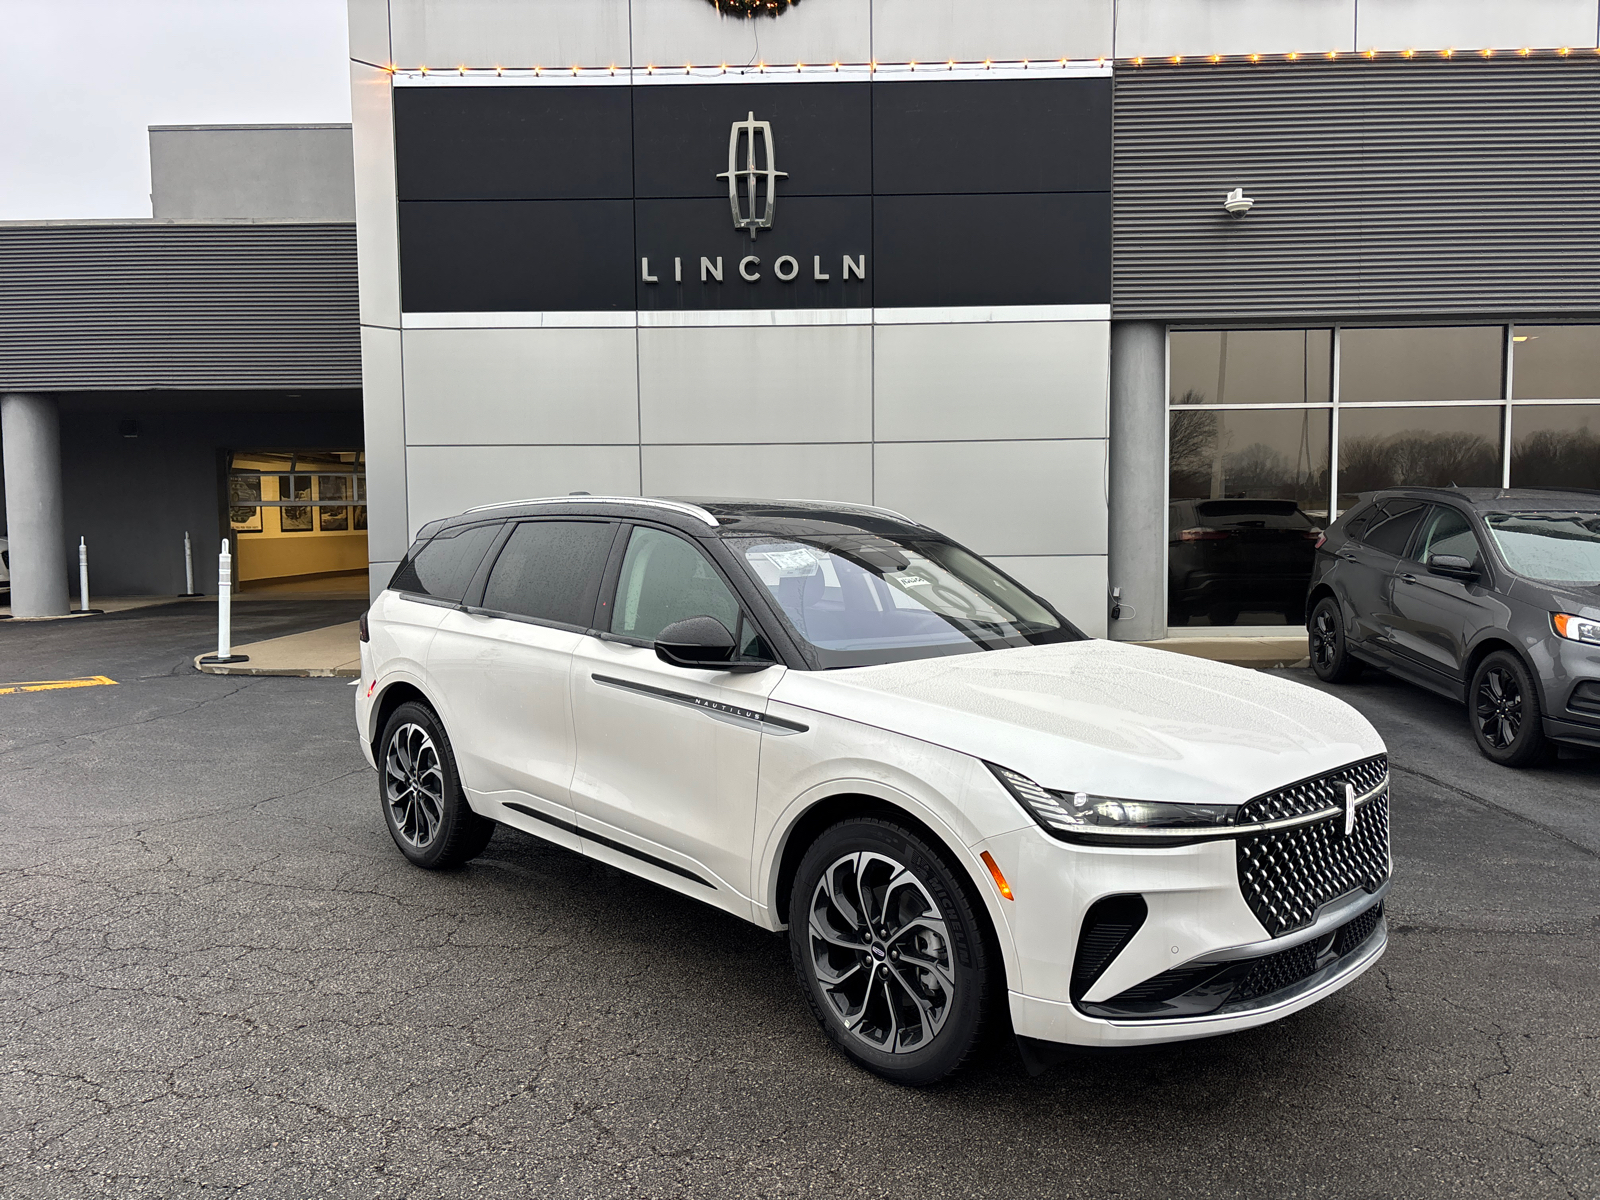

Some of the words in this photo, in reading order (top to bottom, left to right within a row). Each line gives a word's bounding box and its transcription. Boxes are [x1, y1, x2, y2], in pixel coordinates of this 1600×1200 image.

[641, 254, 866, 282] LINCOLN
[694, 698, 760, 720] NAUTILUS
[928, 876, 972, 968] MICHELIN
